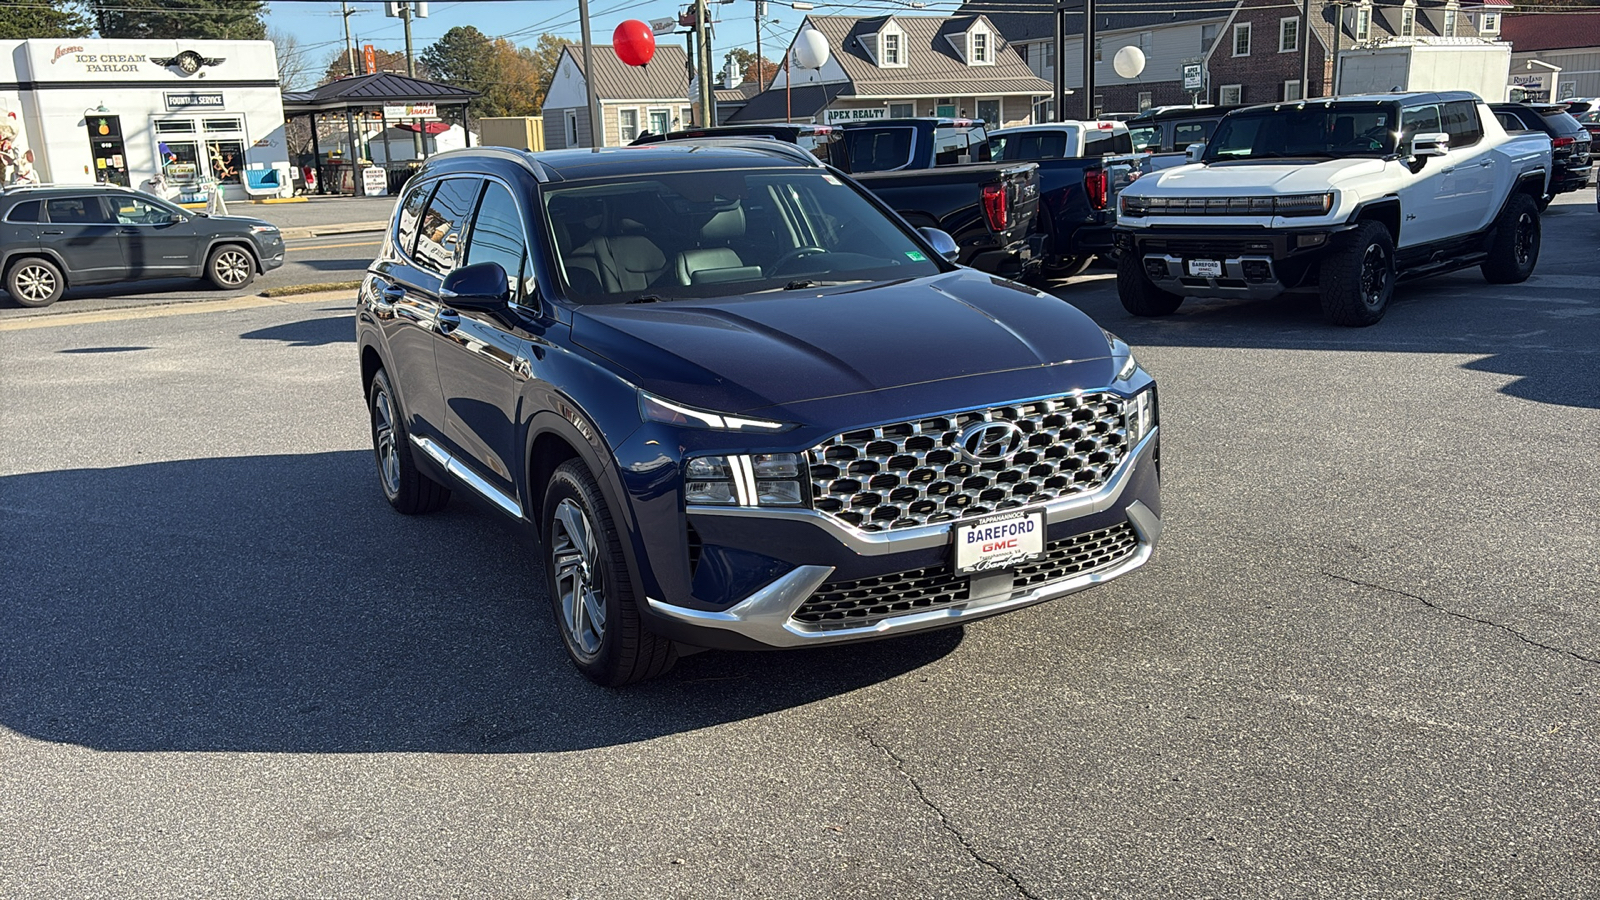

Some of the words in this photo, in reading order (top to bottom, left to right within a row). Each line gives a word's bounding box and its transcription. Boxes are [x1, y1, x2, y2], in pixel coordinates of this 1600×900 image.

[76, 54, 98, 63] ICE
[100, 54, 147, 63] CREAM
[86, 64, 139, 73] PARLOR
[198, 95, 222, 104] SERVICE
[828, 110, 850, 120] APEX
[852, 109, 885, 119] REALTY
[979, 511, 1025, 525] TAPPAHANNOCK
[967, 520, 1034, 544] BAREFORD
[982, 539, 1018, 552] GMC
[976, 551, 1027, 571] Bareford
